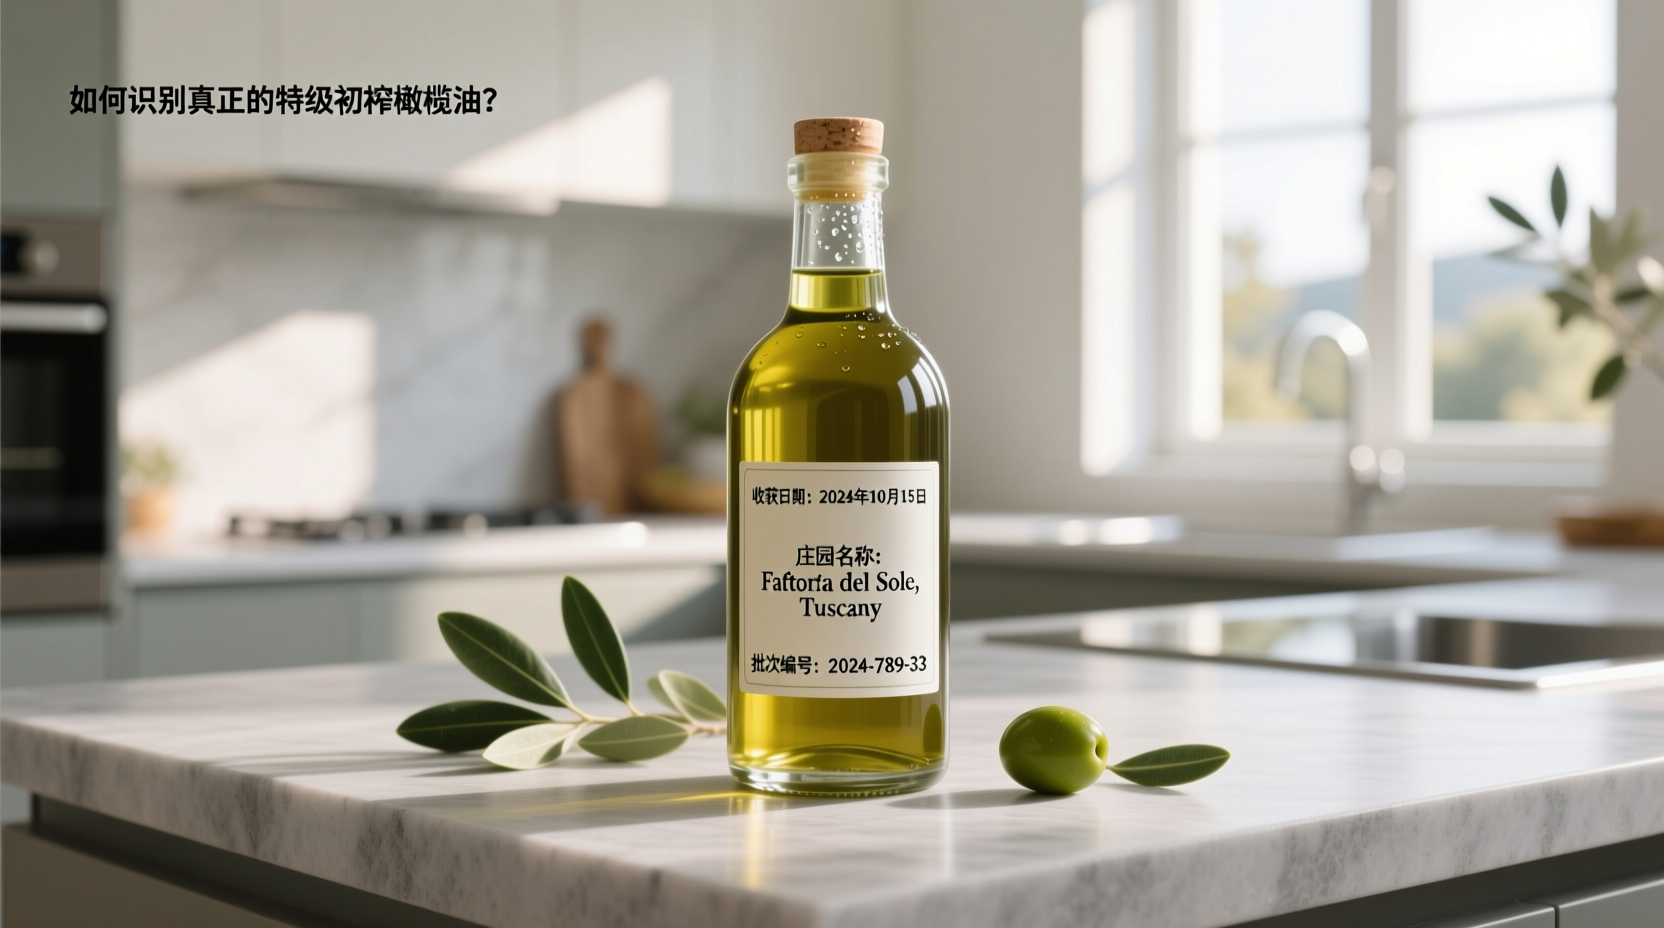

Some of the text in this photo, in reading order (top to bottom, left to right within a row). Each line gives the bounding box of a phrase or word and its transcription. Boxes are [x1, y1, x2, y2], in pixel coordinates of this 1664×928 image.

[839, 571, 870, 592] del
[875, 570, 920, 595] Sole,
[799, 597, 882, 623] Tuscany
